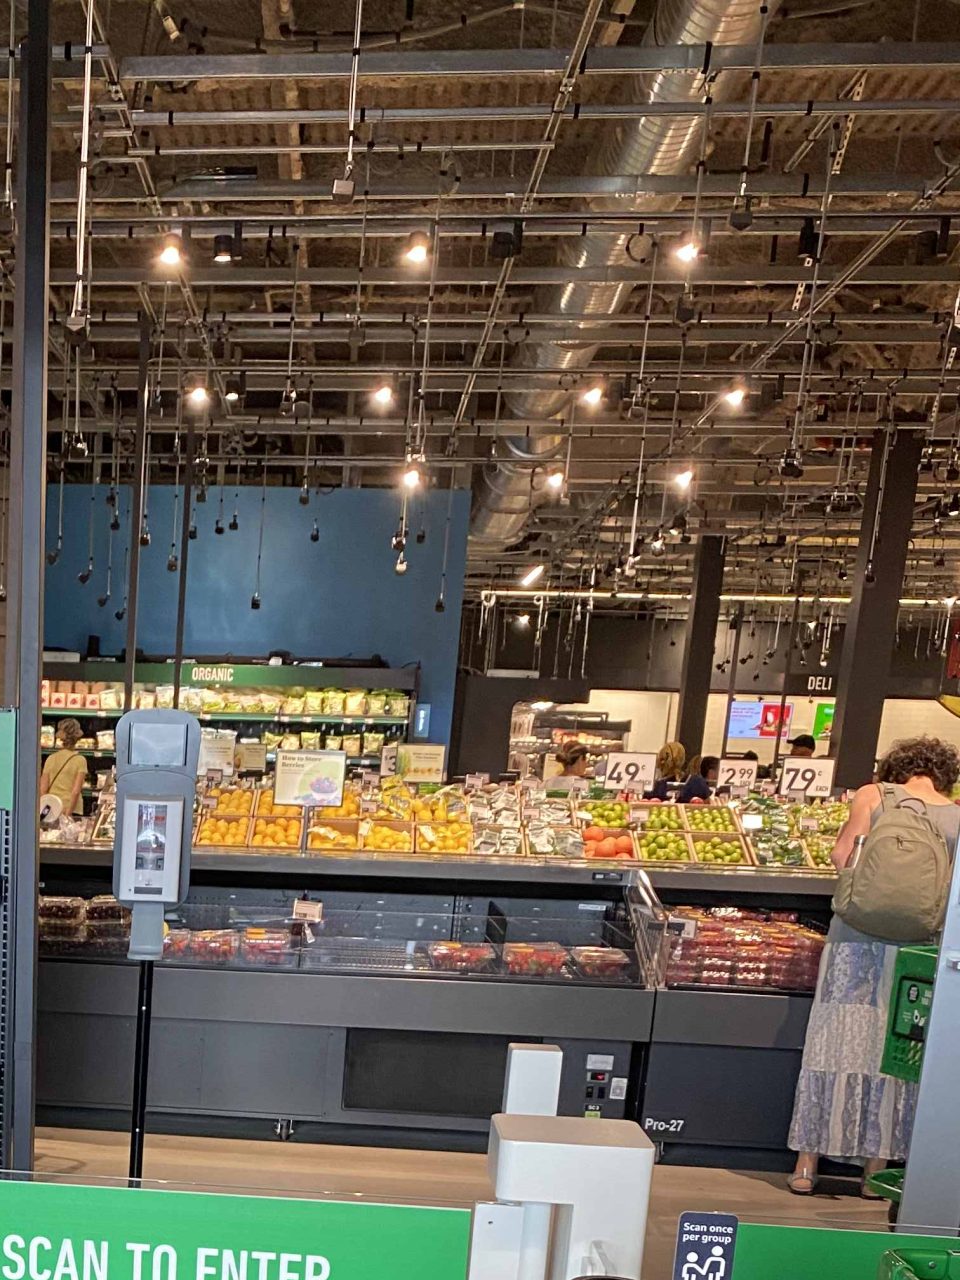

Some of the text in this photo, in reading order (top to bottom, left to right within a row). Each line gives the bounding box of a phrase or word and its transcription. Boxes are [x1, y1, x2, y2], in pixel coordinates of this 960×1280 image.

[191, 667, 234, 682] ORGANIC
[807, 675, 833, 691] DELI
[644, 1117, 685, 1132] Pro-27
[683, 1222, 734, 1235] Scan once
[682, 1233, 732, 1245] per group
